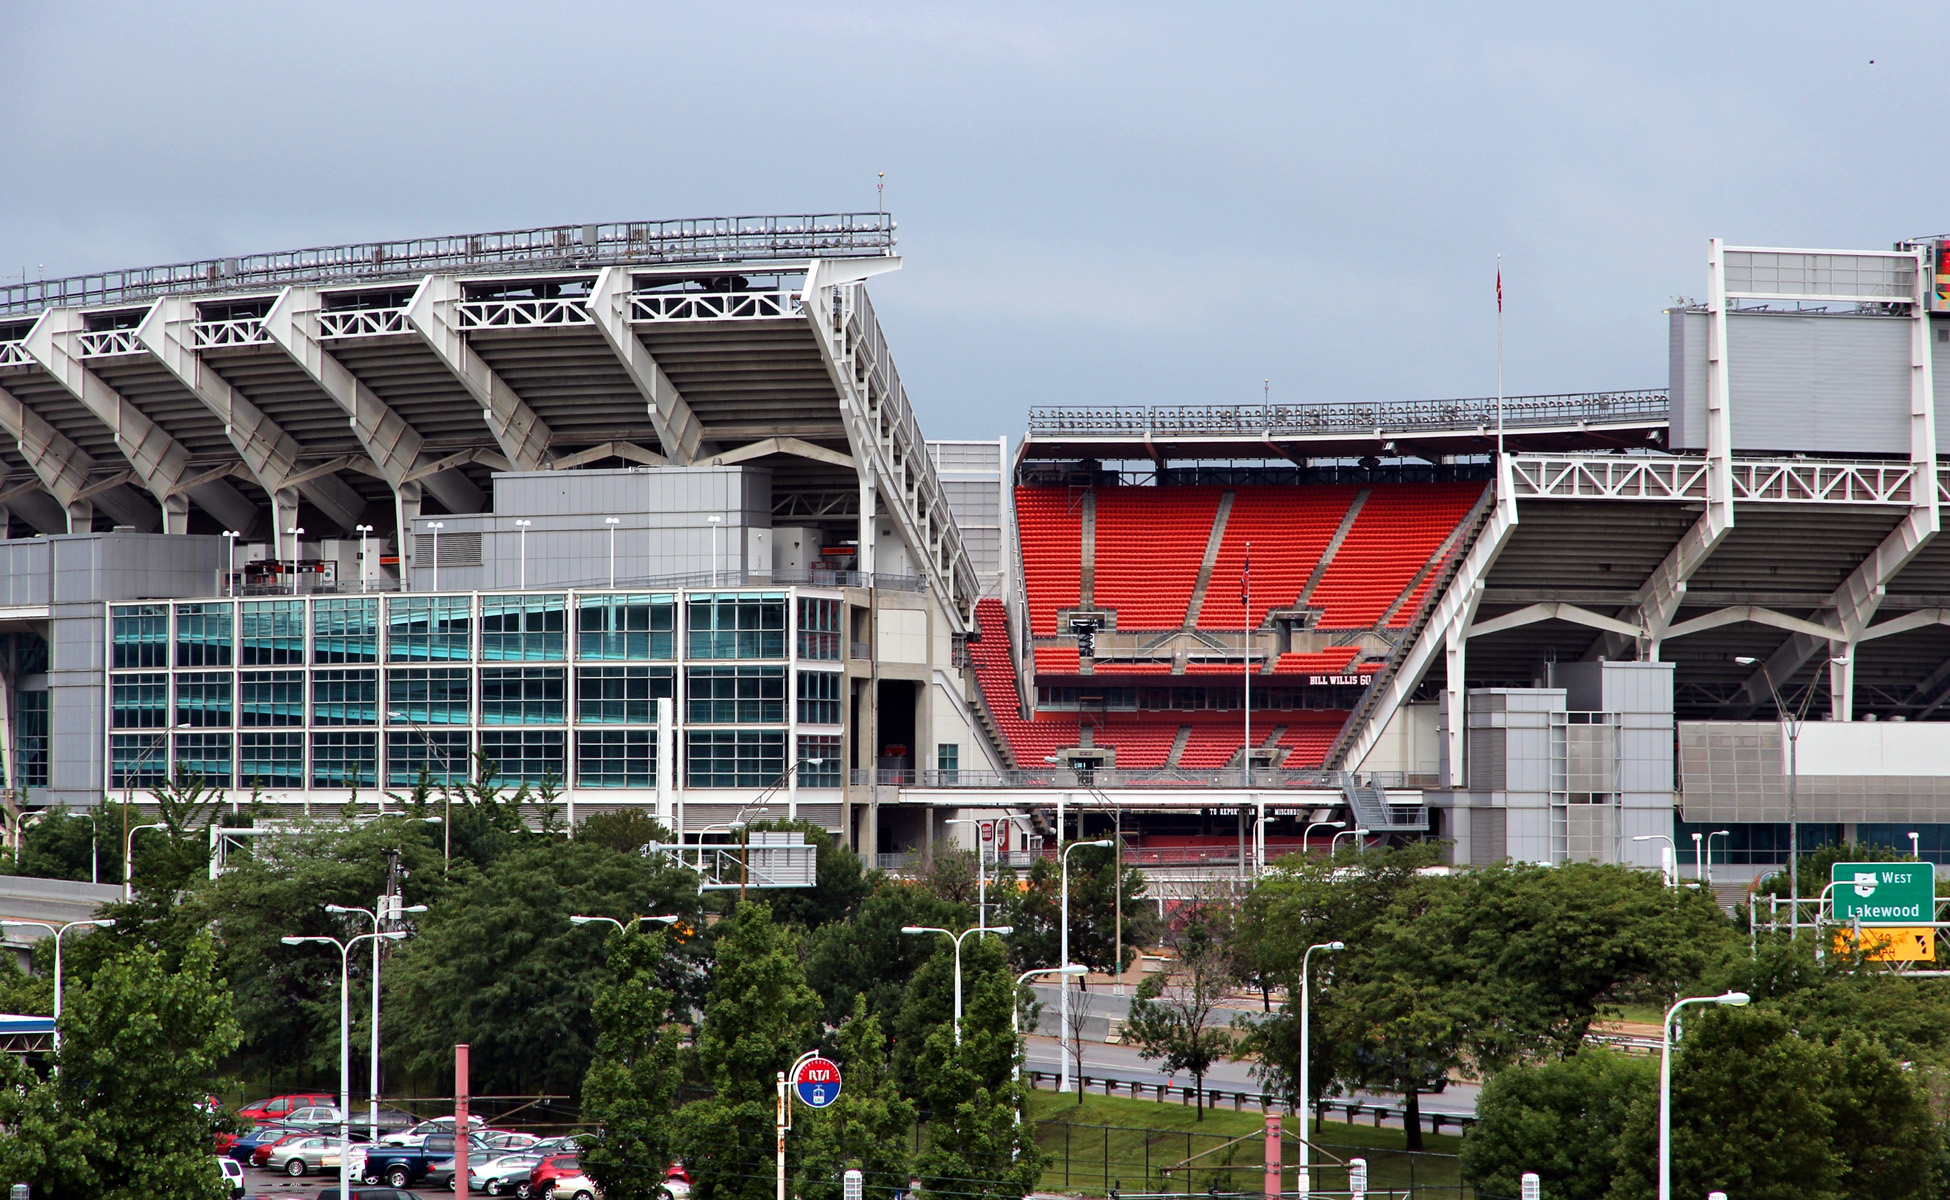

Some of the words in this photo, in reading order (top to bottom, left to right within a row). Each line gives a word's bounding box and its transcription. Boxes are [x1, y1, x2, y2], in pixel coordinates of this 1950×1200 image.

[1309, 675, 1328, 685] BILL
[1329, 675, 1358, 685] WILLIS
[1360, 674, 1372, 686] 60
[1847, 903, 1920, 918] Lakewood
[808, 1069, 830, 1081] RTA
